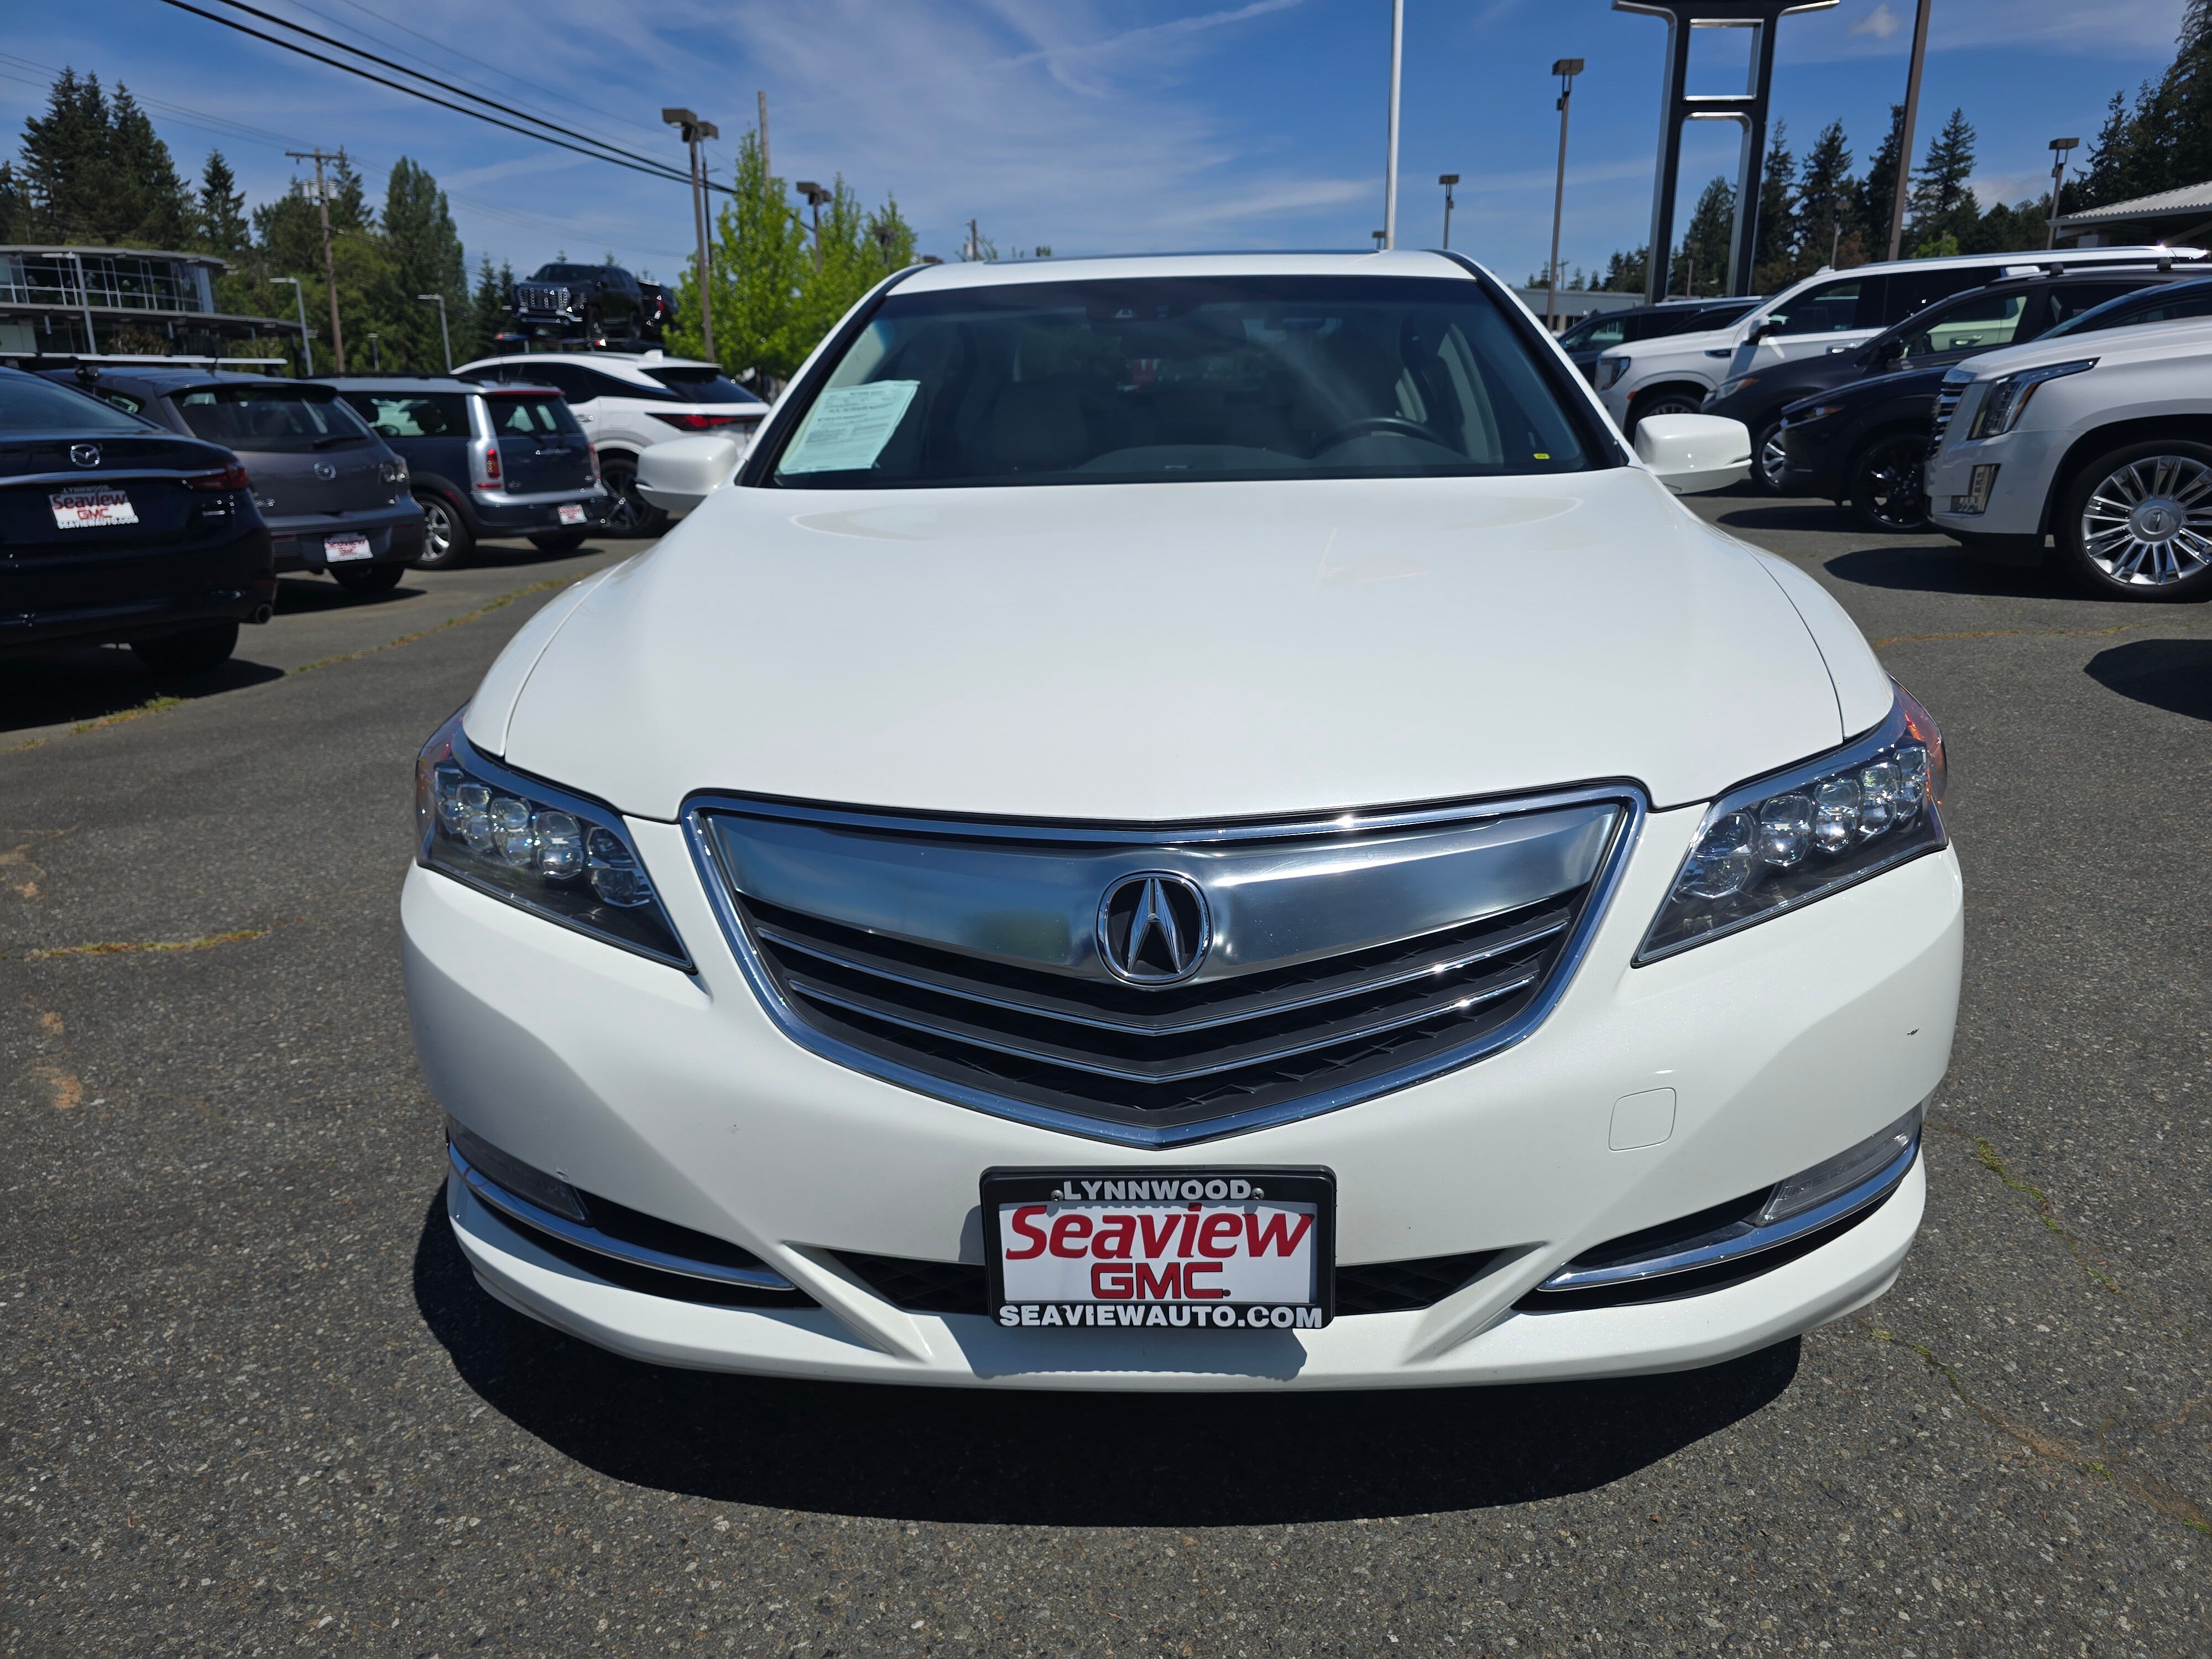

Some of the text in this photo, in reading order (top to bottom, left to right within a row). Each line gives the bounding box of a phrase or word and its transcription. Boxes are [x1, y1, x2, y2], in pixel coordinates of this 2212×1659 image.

[53, 492, 126, 510] Seaview
[77, 508, 112, 520] GMC
[1063, 1180, 1251, 1200] LYNNWOOD
[1005, 1202, 1315, 1260] Seaview
[1091, 1262, 1224, 1300] GMC
[999, 1305, 1322, 1328] SEAVIEWAUTO.COM
